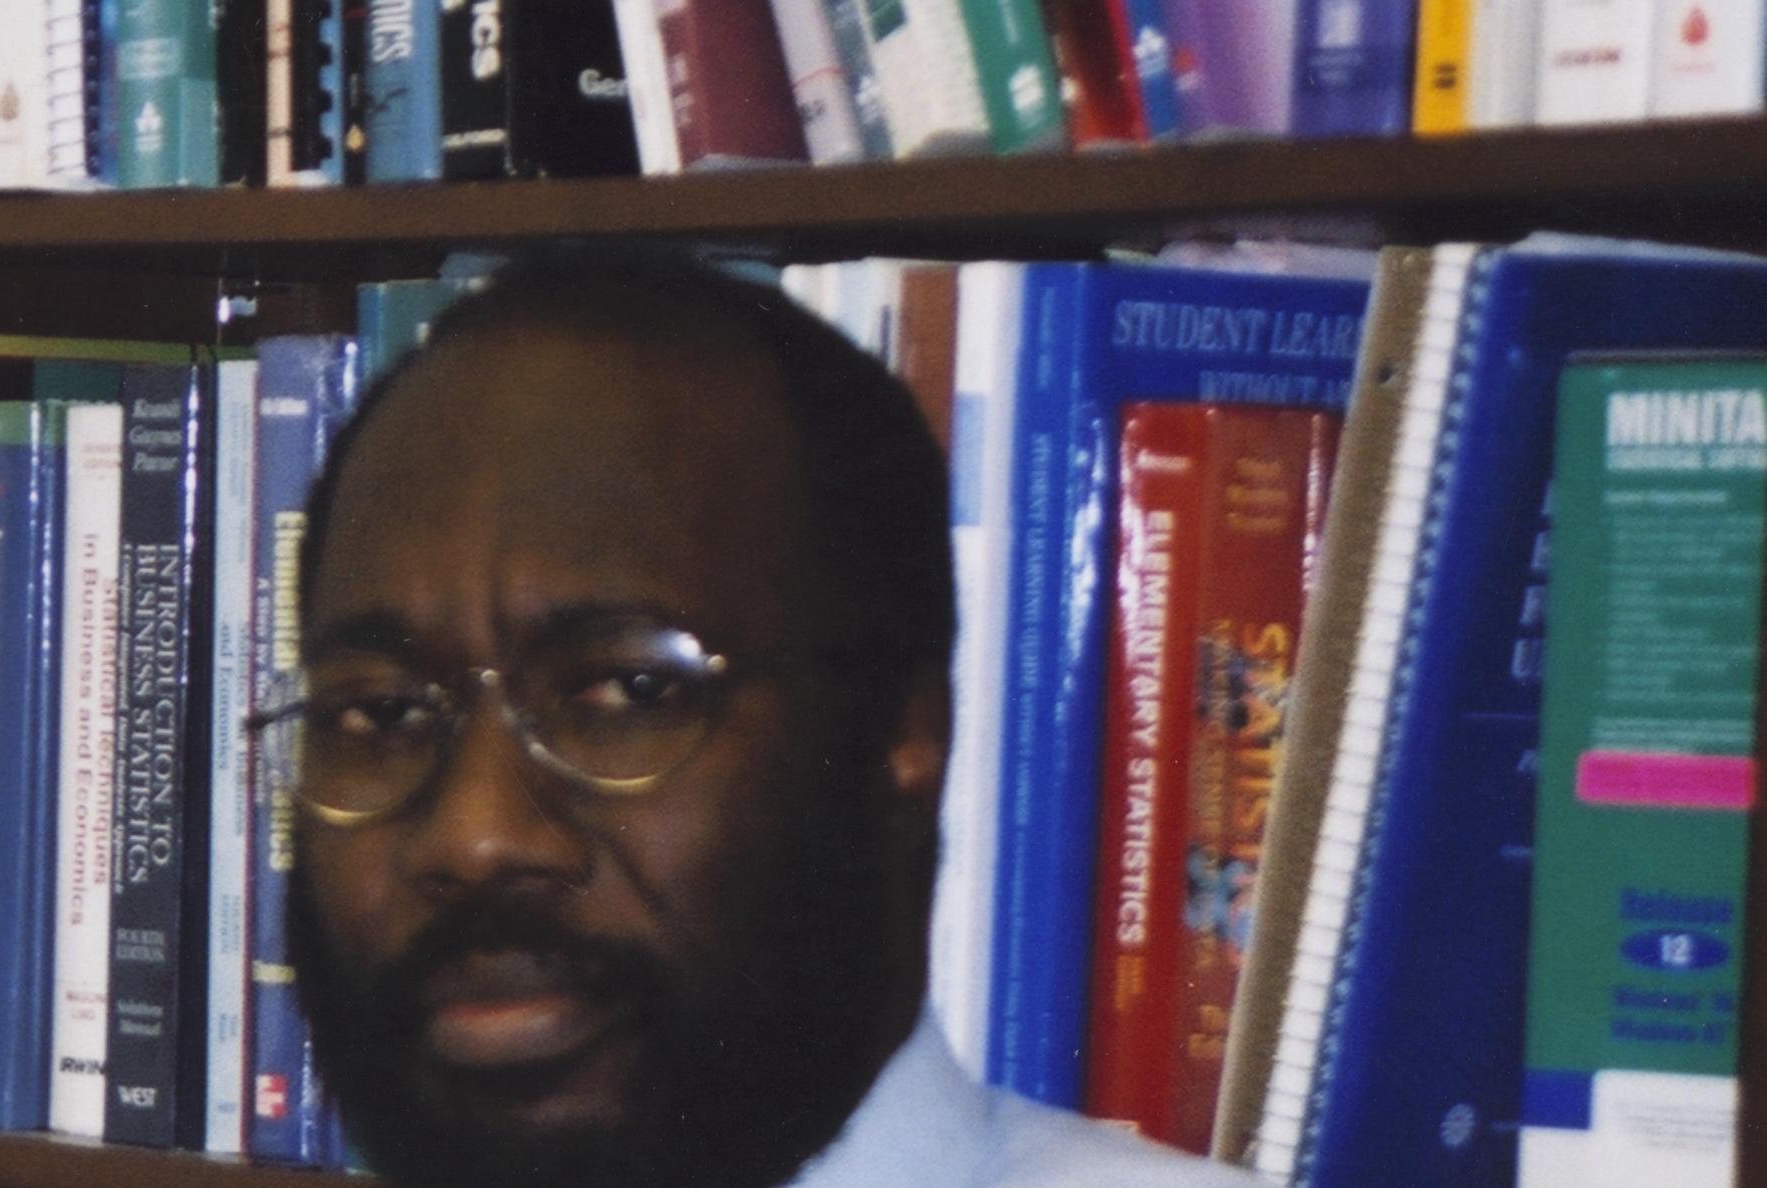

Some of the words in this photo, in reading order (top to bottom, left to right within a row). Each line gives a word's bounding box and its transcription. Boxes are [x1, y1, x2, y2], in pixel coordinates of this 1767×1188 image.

[1113, 300, 1266, 352] STUDENT
[1269, 311, 1369, 359] LEAR
[80, 568, 98, 700] Business
[133, 544, 157, 697] BUSINESS
[152, 544, 179, 802] INTRODUCTION
[1131, 508, 1176, 747] ELEMENTARY
[78, 709, 96, 761] and
[217, 665, 234, 771] Economics
[70, 768, 96, 926] Economics
[93, 729, 118, 886] Techniques
[129, 709, 154, 884] STATISTICS
[151, 815, 173, 866] TO
[1116, 757, 1156, 945] STATISTICS
[1661, 932, 1690, 964] 12
[59, 1056, 106, 1075] IRWIN
[117, 1085, 155, 1106] WEST
